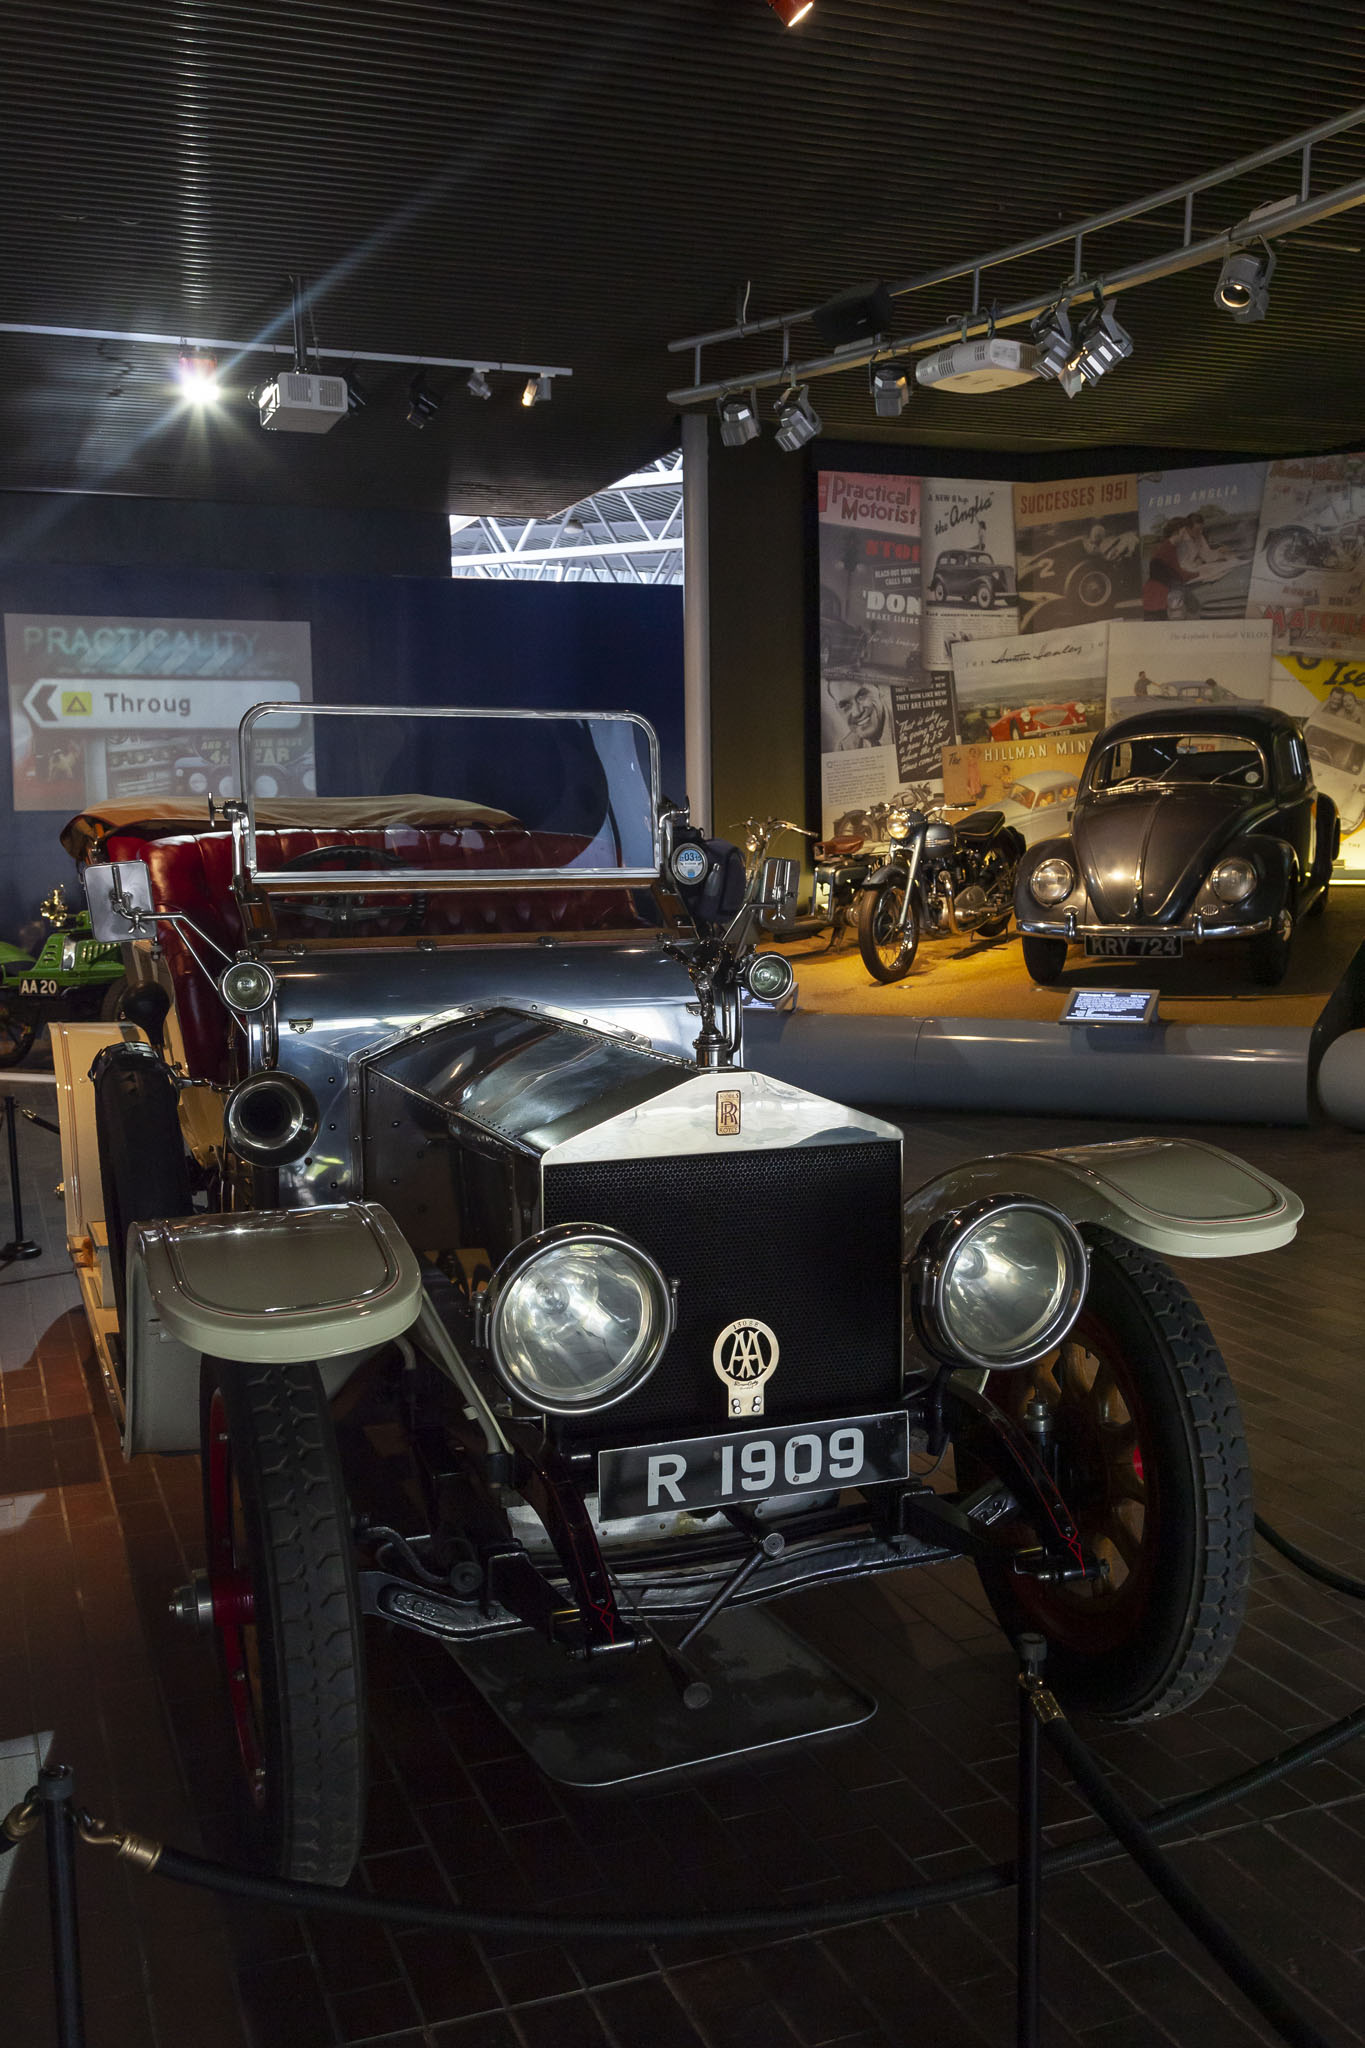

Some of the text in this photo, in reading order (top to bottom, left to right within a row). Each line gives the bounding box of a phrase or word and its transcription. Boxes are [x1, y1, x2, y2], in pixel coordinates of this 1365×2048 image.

[832, 475, 911, 505] Practical
[1020, 480, 1128, 514] SUCCESSES 1951
[1148, 484, 1238, 506] FORD ANGLIA
[841, 497, 917, 524] Motorist
[934, 520, 948, 535] the
[1038, 558, 1056, 578] 2
[24, 626, 258, 658] PRACTICALITY
[1240, 632, 1271, 640] VELOX
[104, 692, 191, 717] Throug
[896, 703, 910, 711] THEY
[935, 699, 948, 707] NEW
[984, 744, 1048, 761] HILLMAN
[1056, 740, 1093, 755] MIN
[684, 852, 694, 861] 03
[1092, 937, 1129, 954] KRY
[20, 979, 57, 994] AA 20
[647, 1427, 865, 1507] R 1909
